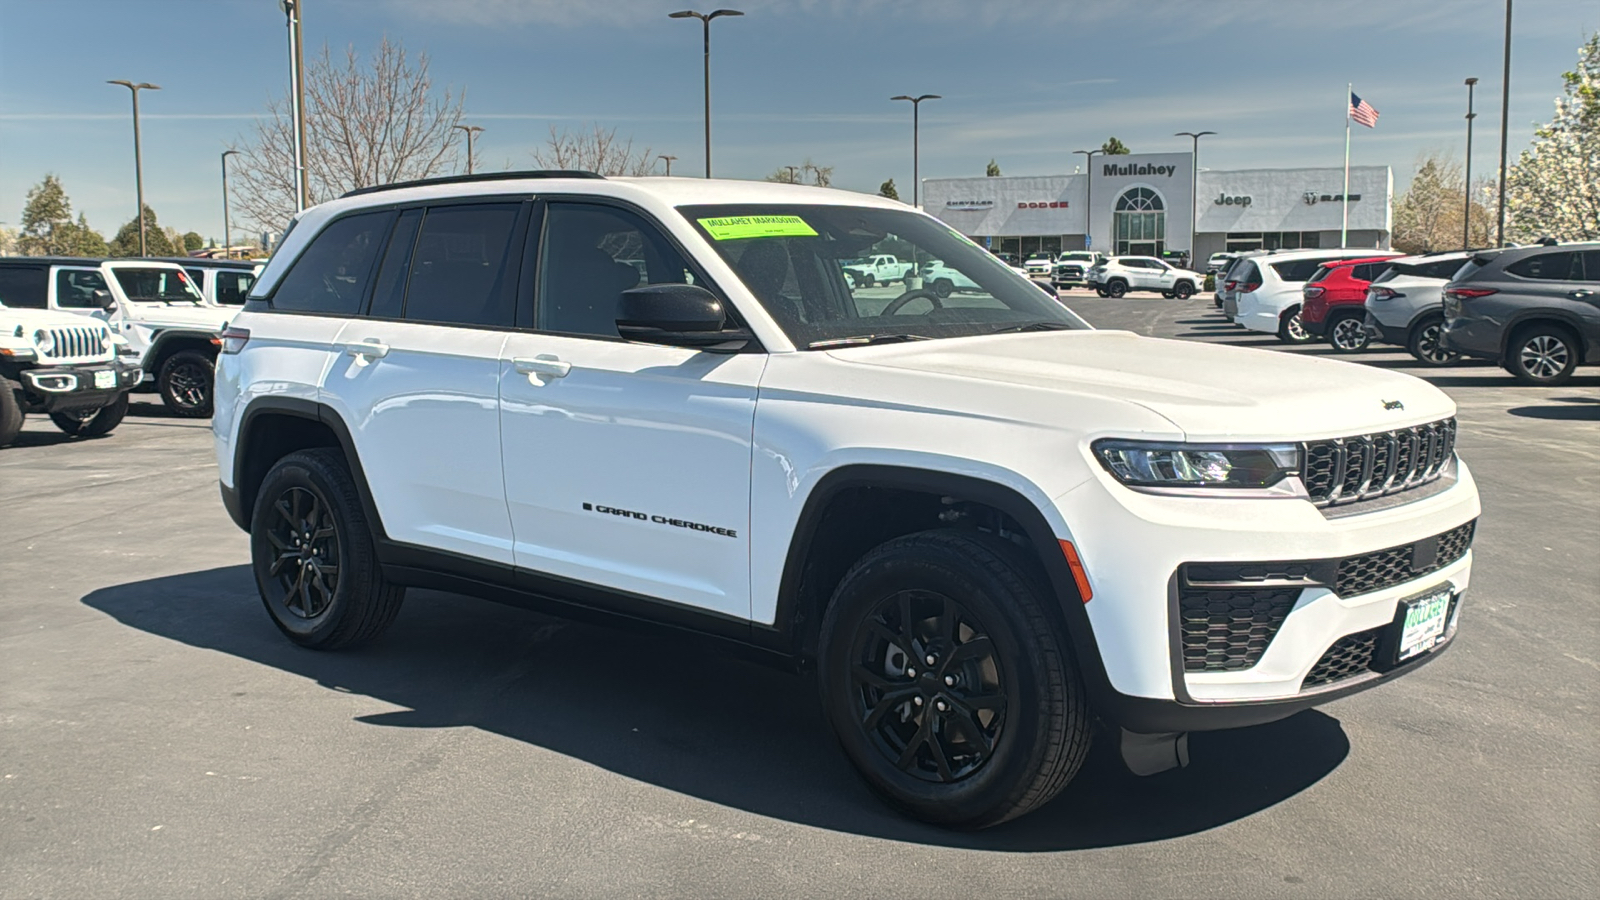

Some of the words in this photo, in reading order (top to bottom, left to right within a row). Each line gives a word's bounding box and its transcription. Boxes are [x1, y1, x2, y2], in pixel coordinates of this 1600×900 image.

[1103, 163, 1176, 178] Mullahey
[1018, 201, 1069, 209] DODGE
[1214, 192, 1252, 208] Jeep
[707, 217, 753, 227] MULLAHEY
[596, 505, 648, 521] GRAND
[651, 515, 738, 538] CHEROKEE
